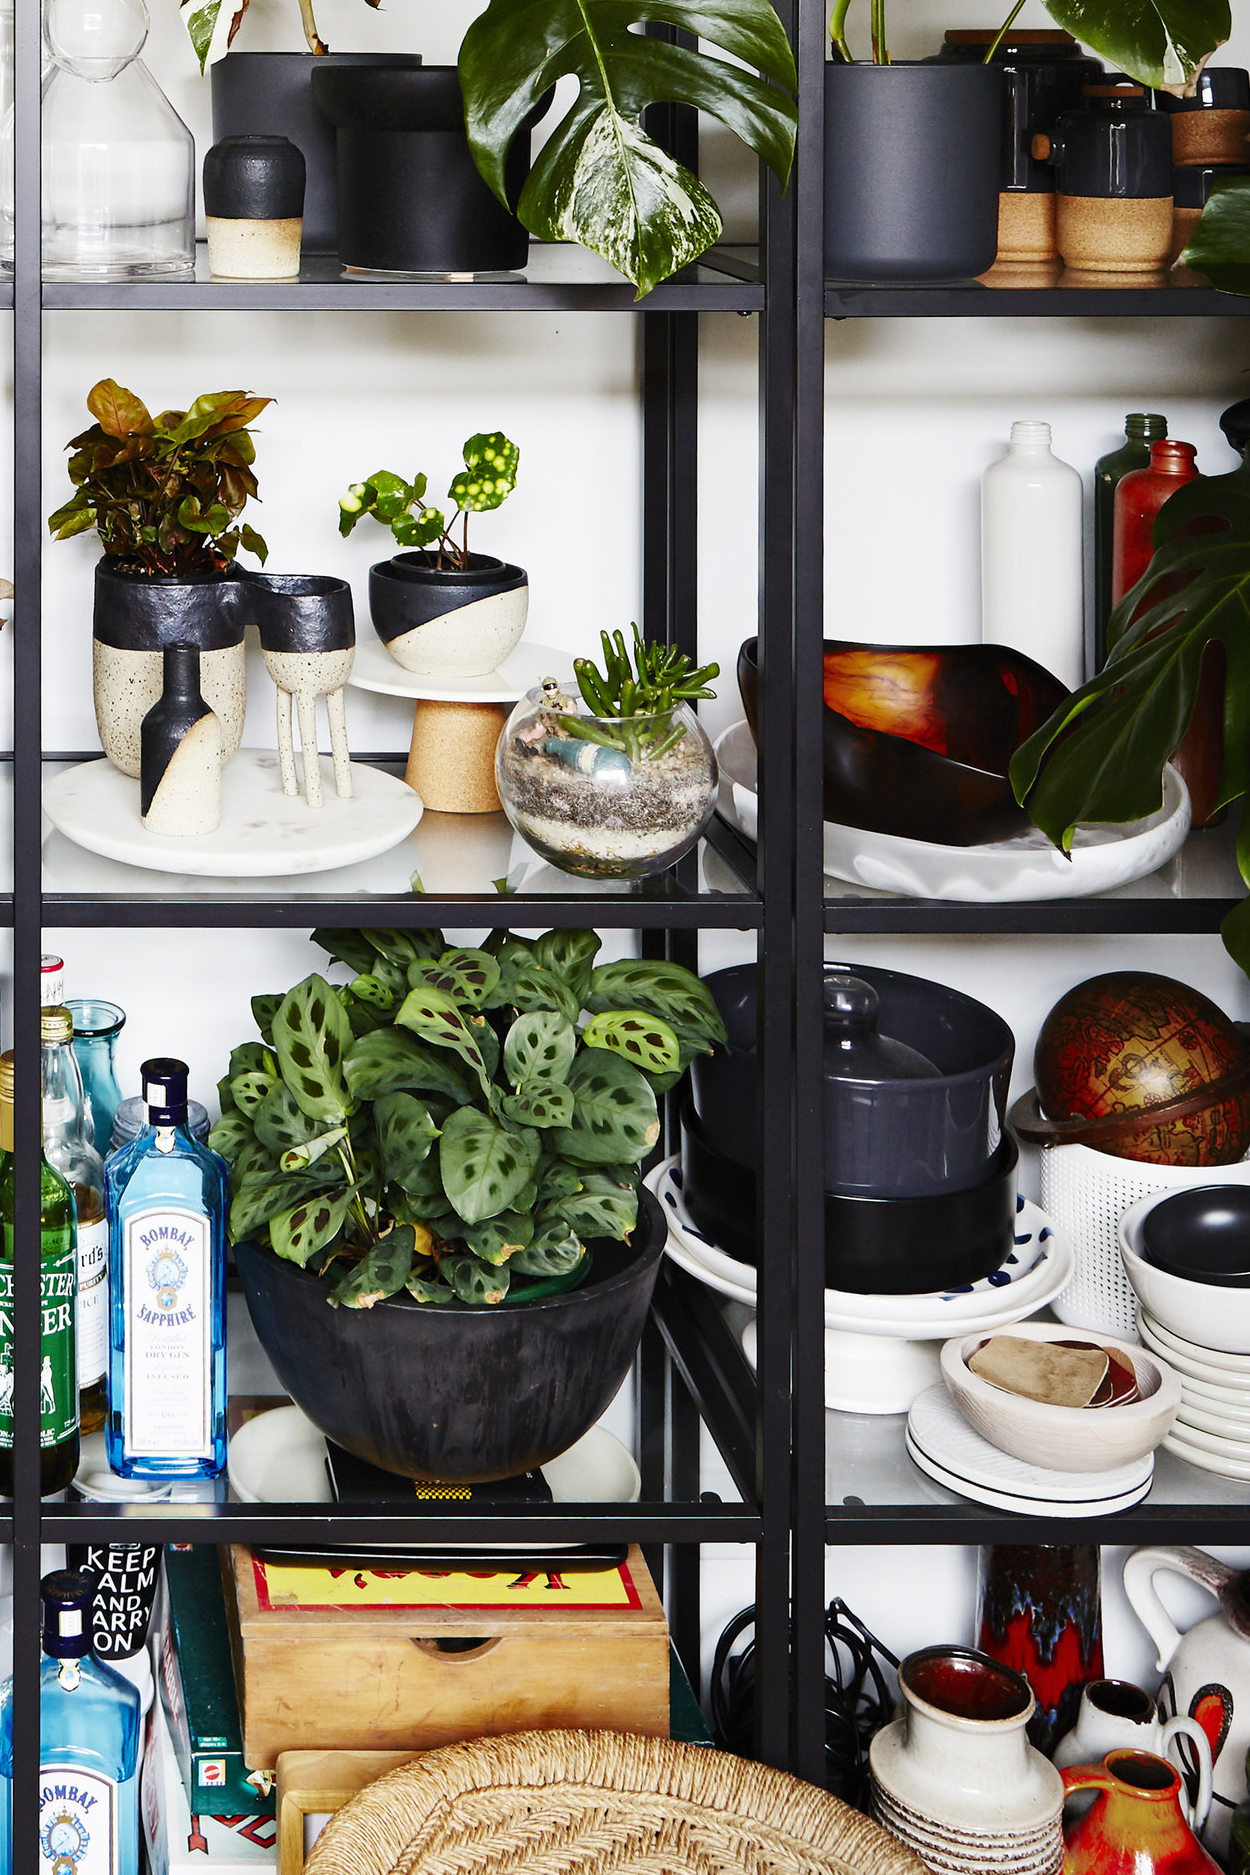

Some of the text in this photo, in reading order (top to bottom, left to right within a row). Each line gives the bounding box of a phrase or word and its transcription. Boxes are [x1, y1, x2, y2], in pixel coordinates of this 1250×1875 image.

[139, 1226, 195, 1251] BOMBAY
[137, 1303, 196, 1327] SAPPHIRE
[87, 1545, 156, 1573] KEEP
[92, 1593, 141, 1612] AND
[92, 1606, 150, 1632] ARRY
[93, 1631, 133, 1653] ON
